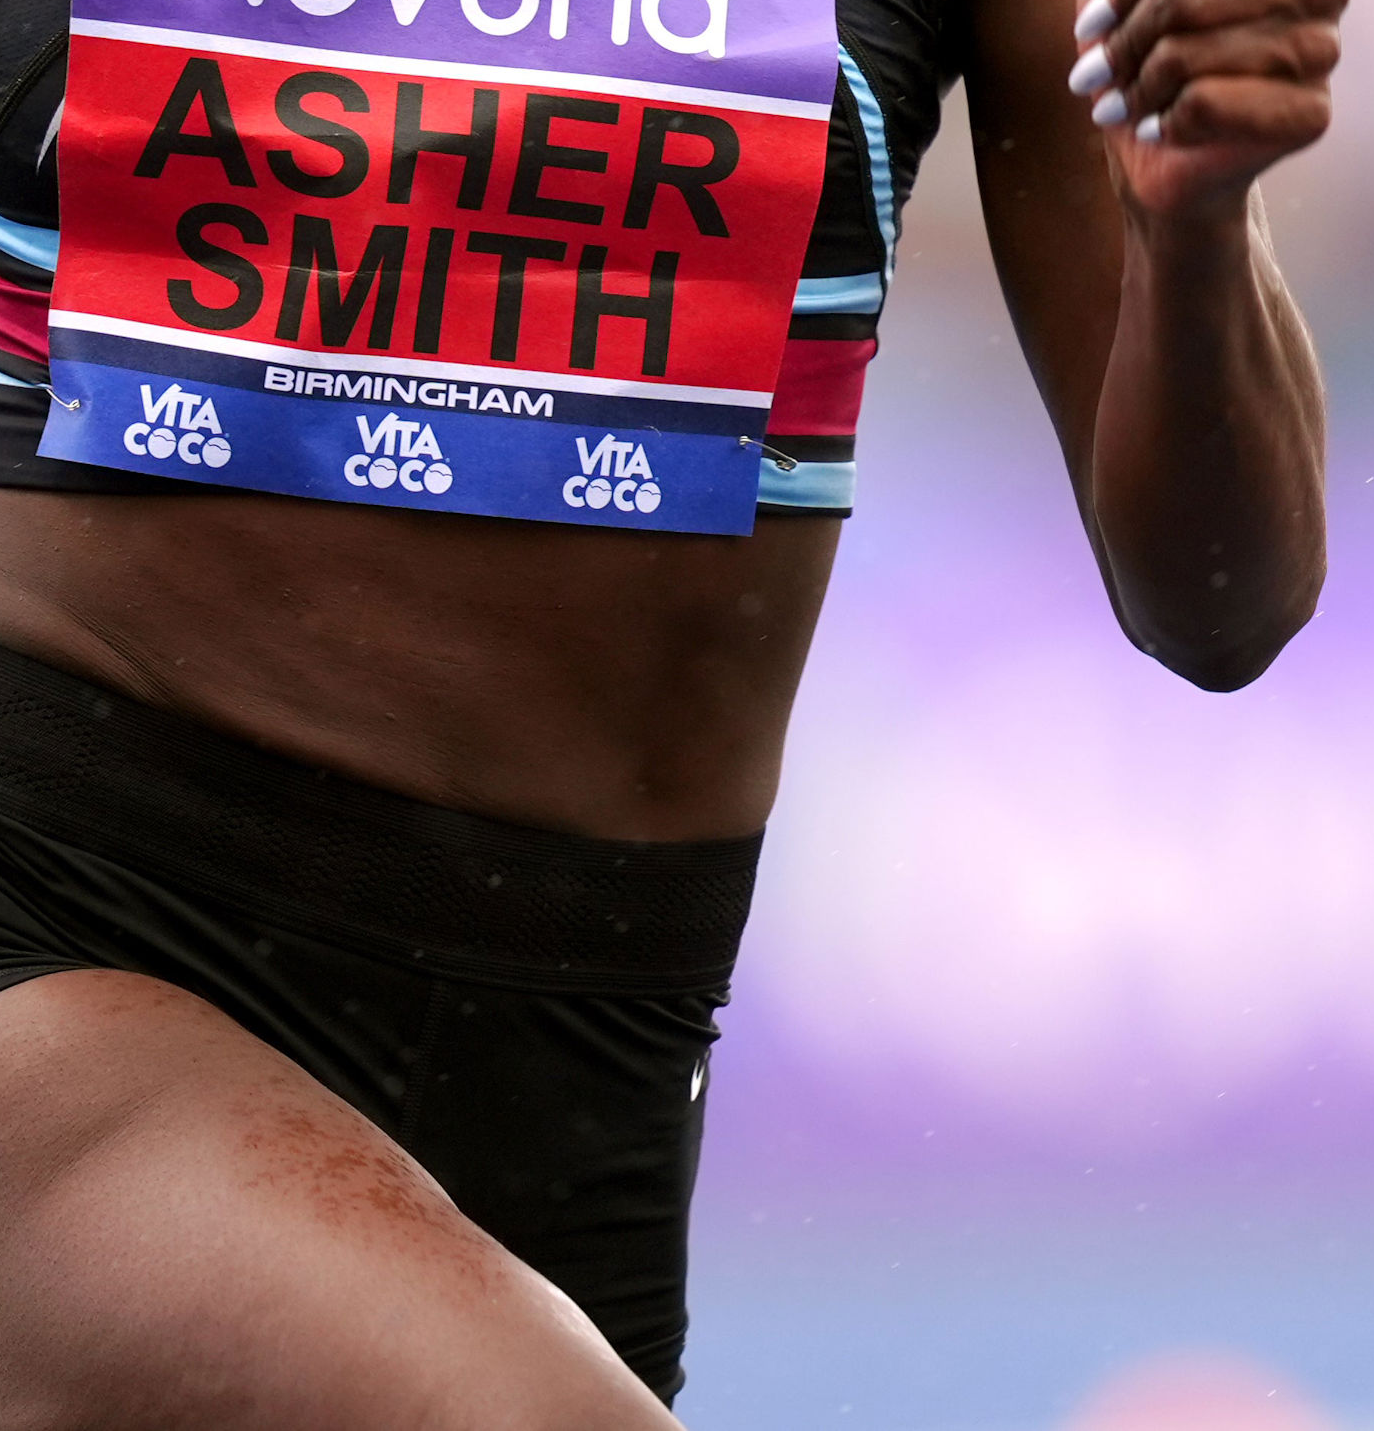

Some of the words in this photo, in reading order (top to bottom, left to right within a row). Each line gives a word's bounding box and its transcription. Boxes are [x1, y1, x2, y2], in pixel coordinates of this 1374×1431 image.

[132, 57, 741, 238] ASHER
[165, 201, 681, 377] SMITH
[140, 383, 223, 434] VITA
[263, 366, 555, 417] BIRMINGHAM
[123, 422, 232, 468] COCO
[355, 412, 444, 461] VITA
[575, 433, 654, 480] VITA
[343, 454, 454, 495] COCO
[562, 475, 662, 514] COCO
